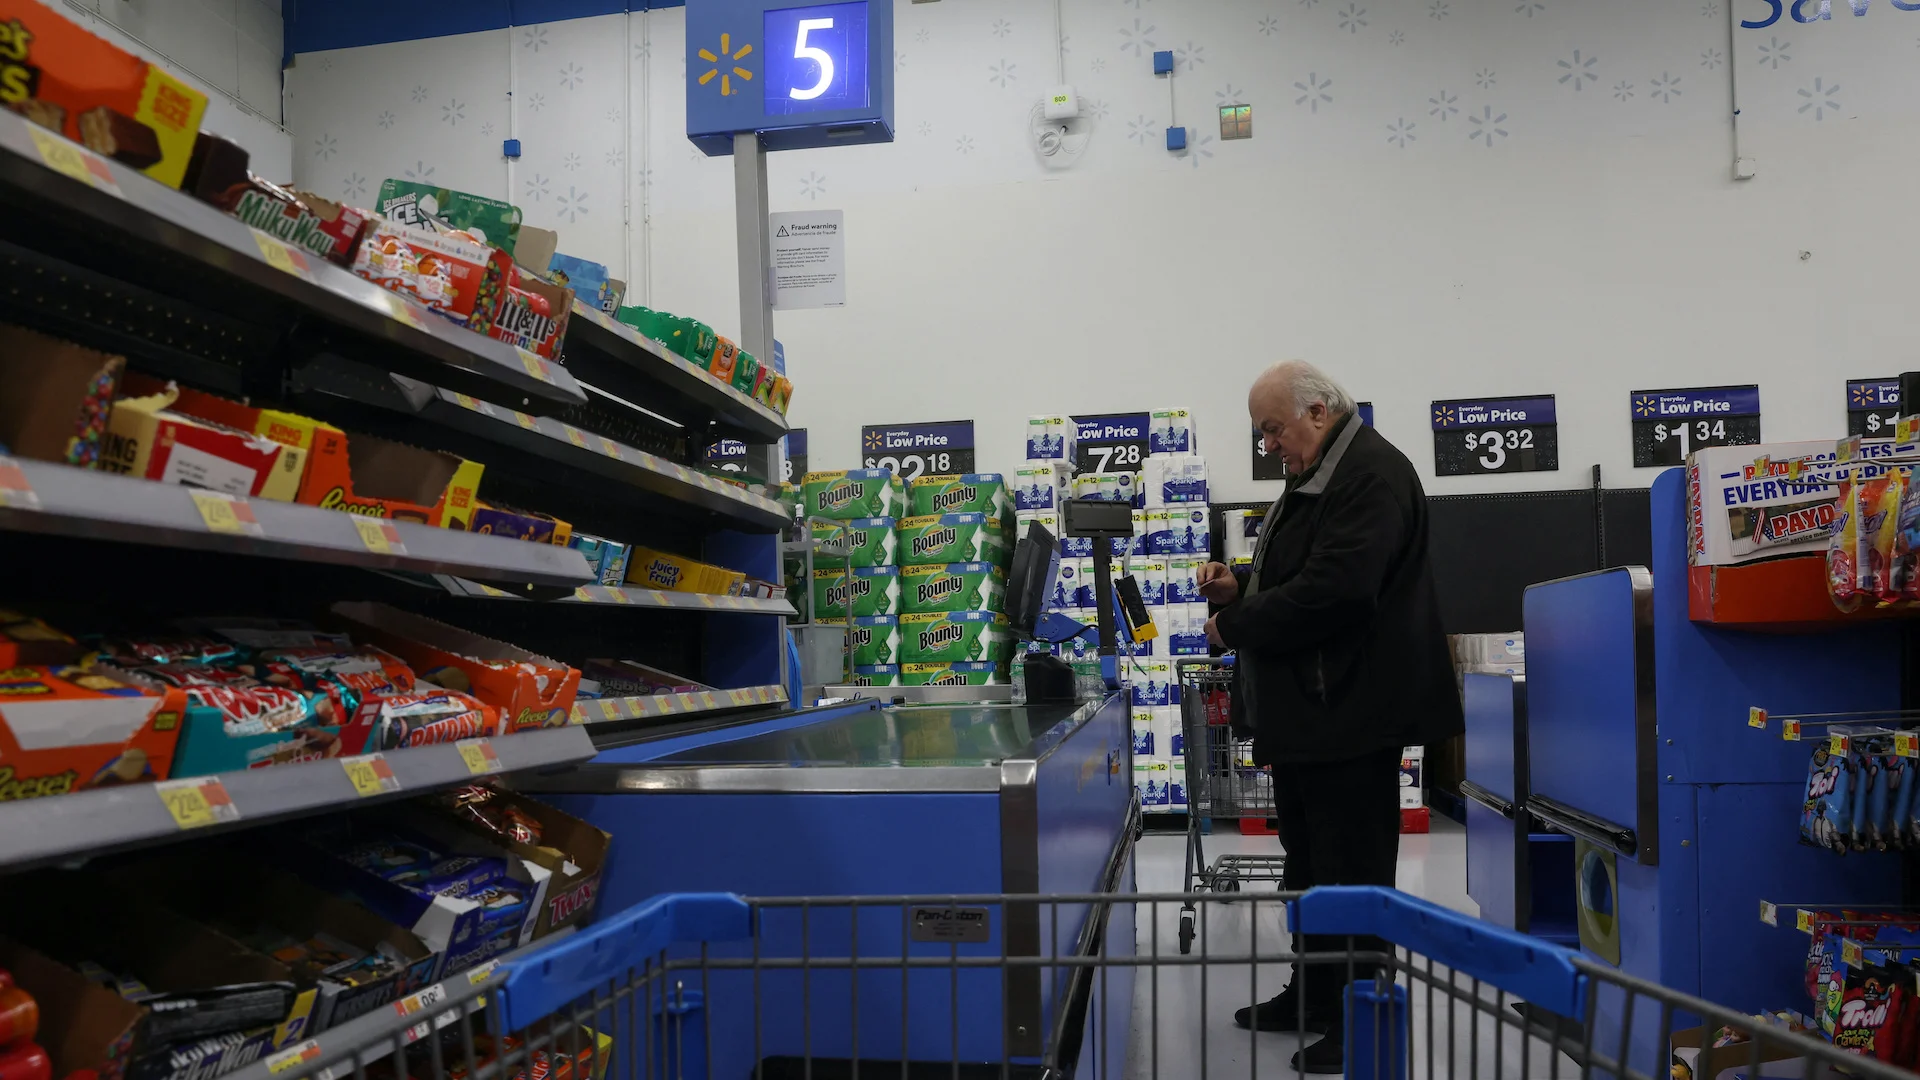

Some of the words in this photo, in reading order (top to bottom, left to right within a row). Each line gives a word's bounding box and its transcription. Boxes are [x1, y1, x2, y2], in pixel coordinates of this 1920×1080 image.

[789, 17, 834, 100] 5
[1660, 395, 1686, 403] Everyday
[1879, 392, 1900, 403] Lo
[1660, 402, 1691, 414] Low
[1693, 400, 1730, 412] Price
[1458, 412, 1488, 424] Low
[1491, 409, 1527, 422] Price
[1076, 428, 1103, 439] Low
[1105, 425, 1139, 438] Price
[886, 436, 913, 448] Low
[915, 434, 948, 446] Price
[1158, 437, 1185, 447] Sparkle
[721, 443, 747, 455] Low
[1033, 444, 1060, 453] Sparkle
[1816, 444, 1892, 470] SATES
[935, 474, 956, 482] DOUBLES
[1171, 476, 1197, 486] Sparkle
[1724, 471, 1831, 505] EVERYDAY
[818, 481, 865, 511] Bounty
[933, 485, 977, 513] Bounty
[1022, 493, 1049, 503] Sparkle
[1690, 462, 1705, 555] PAYDAY
[1771, 504, 1836, 538] PAYD
[912, 528, 957, 557] Bounty
[1156, 534, 1188, 547] Sparkle
[649, 559, 680, 576] Juicy
[648, 571, 678, 588] Fruit
[918, 576, 963, 604] Bounty
[919, 623, 963, 651] Bounty
[1177, 630, 1202, 639] Sparkle
[1138, 691, 1166, 700] Sparkle
[410, 711, 478, 748] PAYDAY
[916, 909, 983, 921] Pan-Oton
